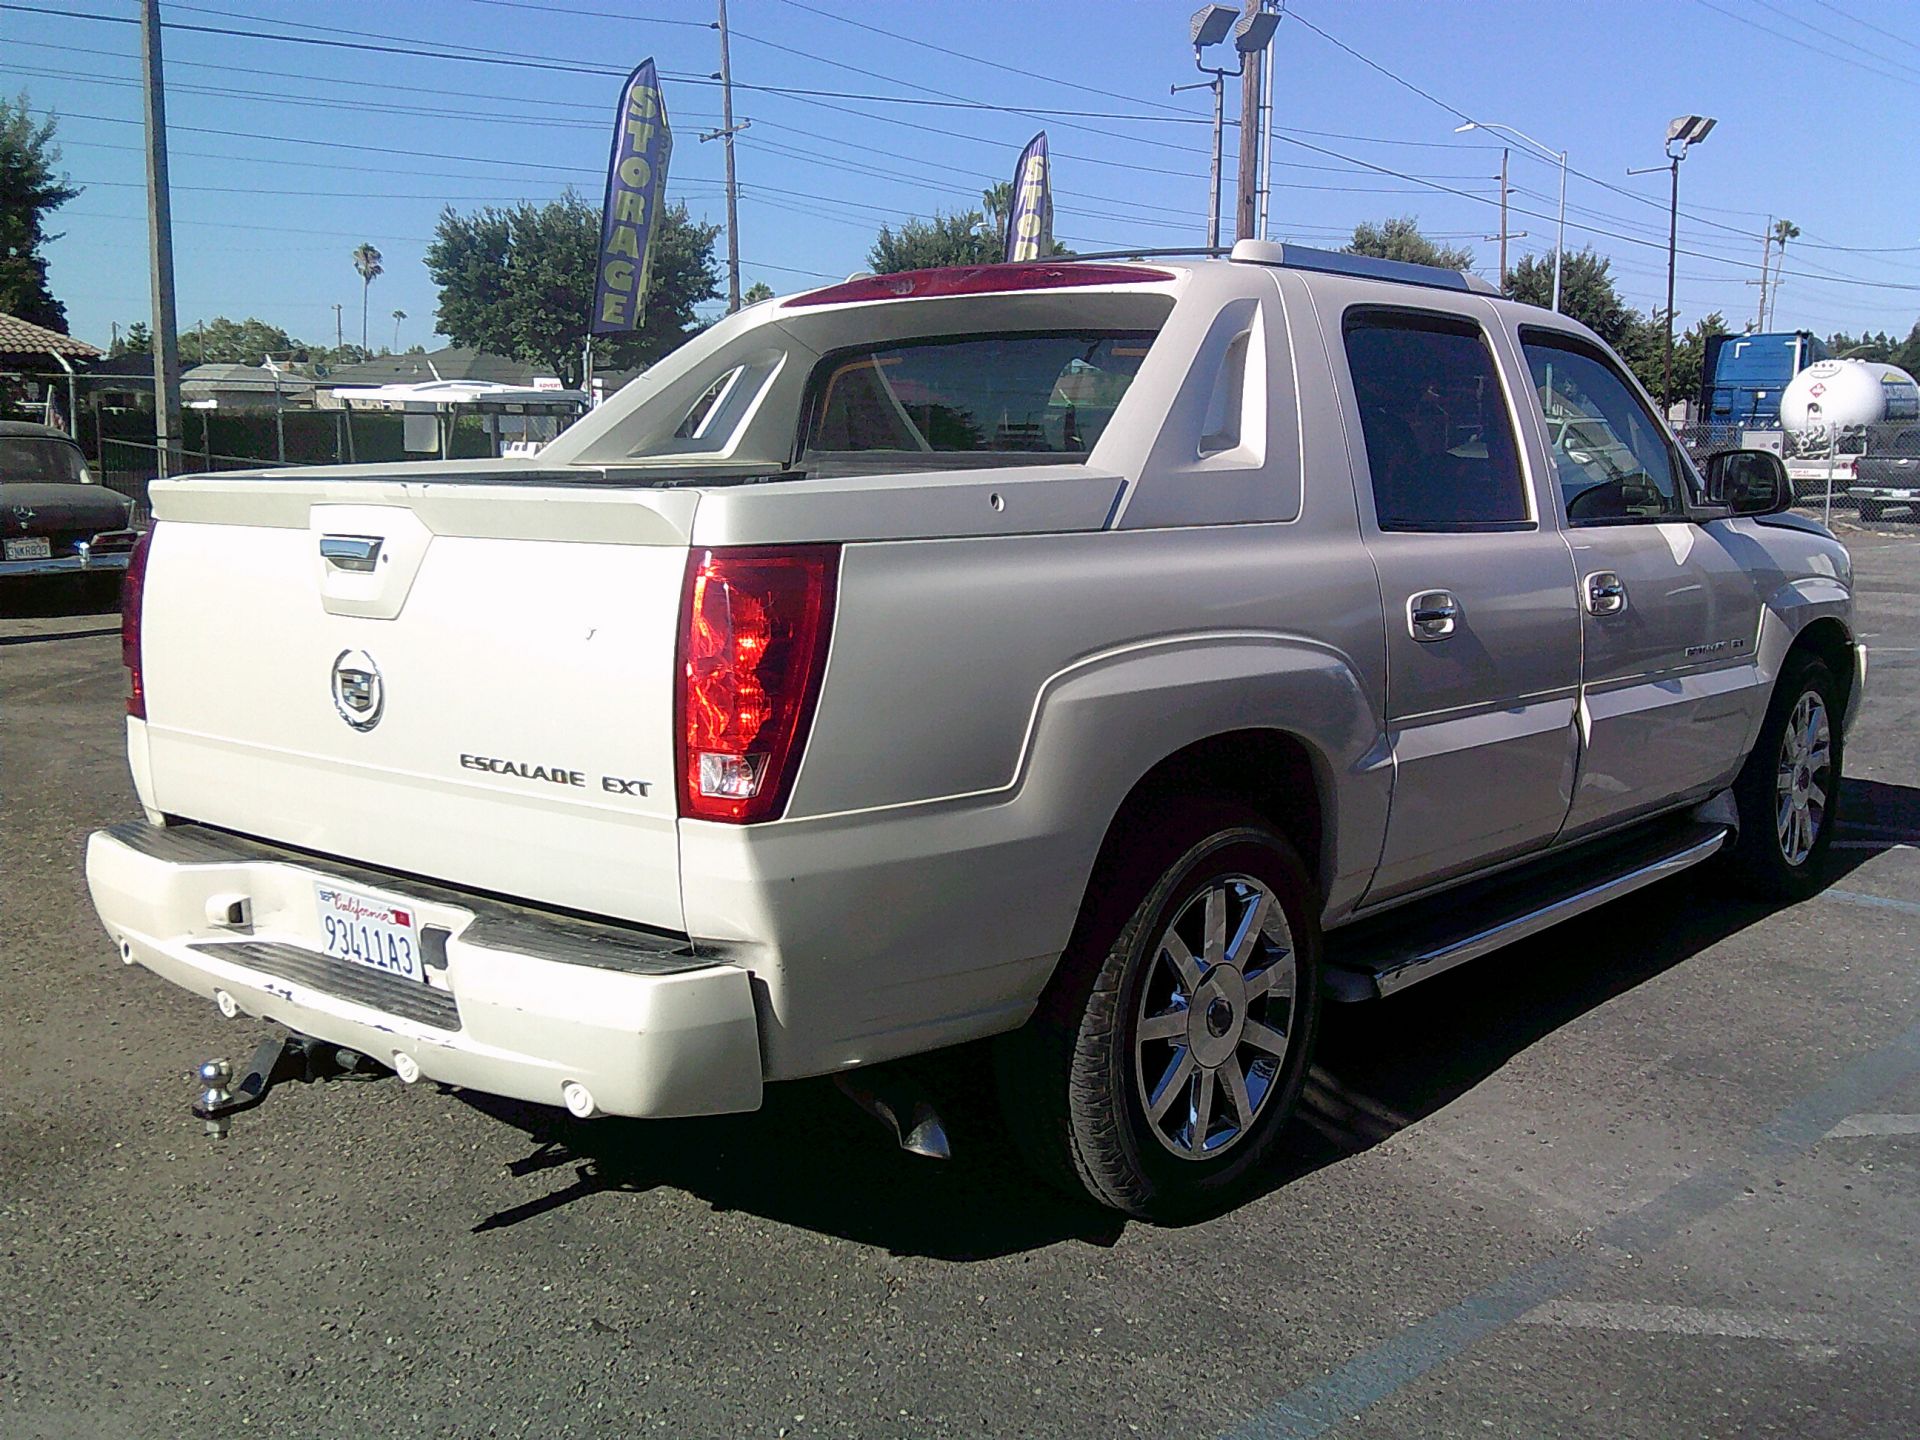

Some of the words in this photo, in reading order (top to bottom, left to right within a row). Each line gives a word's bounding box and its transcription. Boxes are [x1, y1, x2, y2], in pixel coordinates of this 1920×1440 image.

[601, 84, 657, 325] STORAGE
[460, 753, 586, 787] ESCALADE
[602, 776, 653, 797] EXT
[334, 892, 388, 921] California
[325, 915, 413, 975] 93411A3
